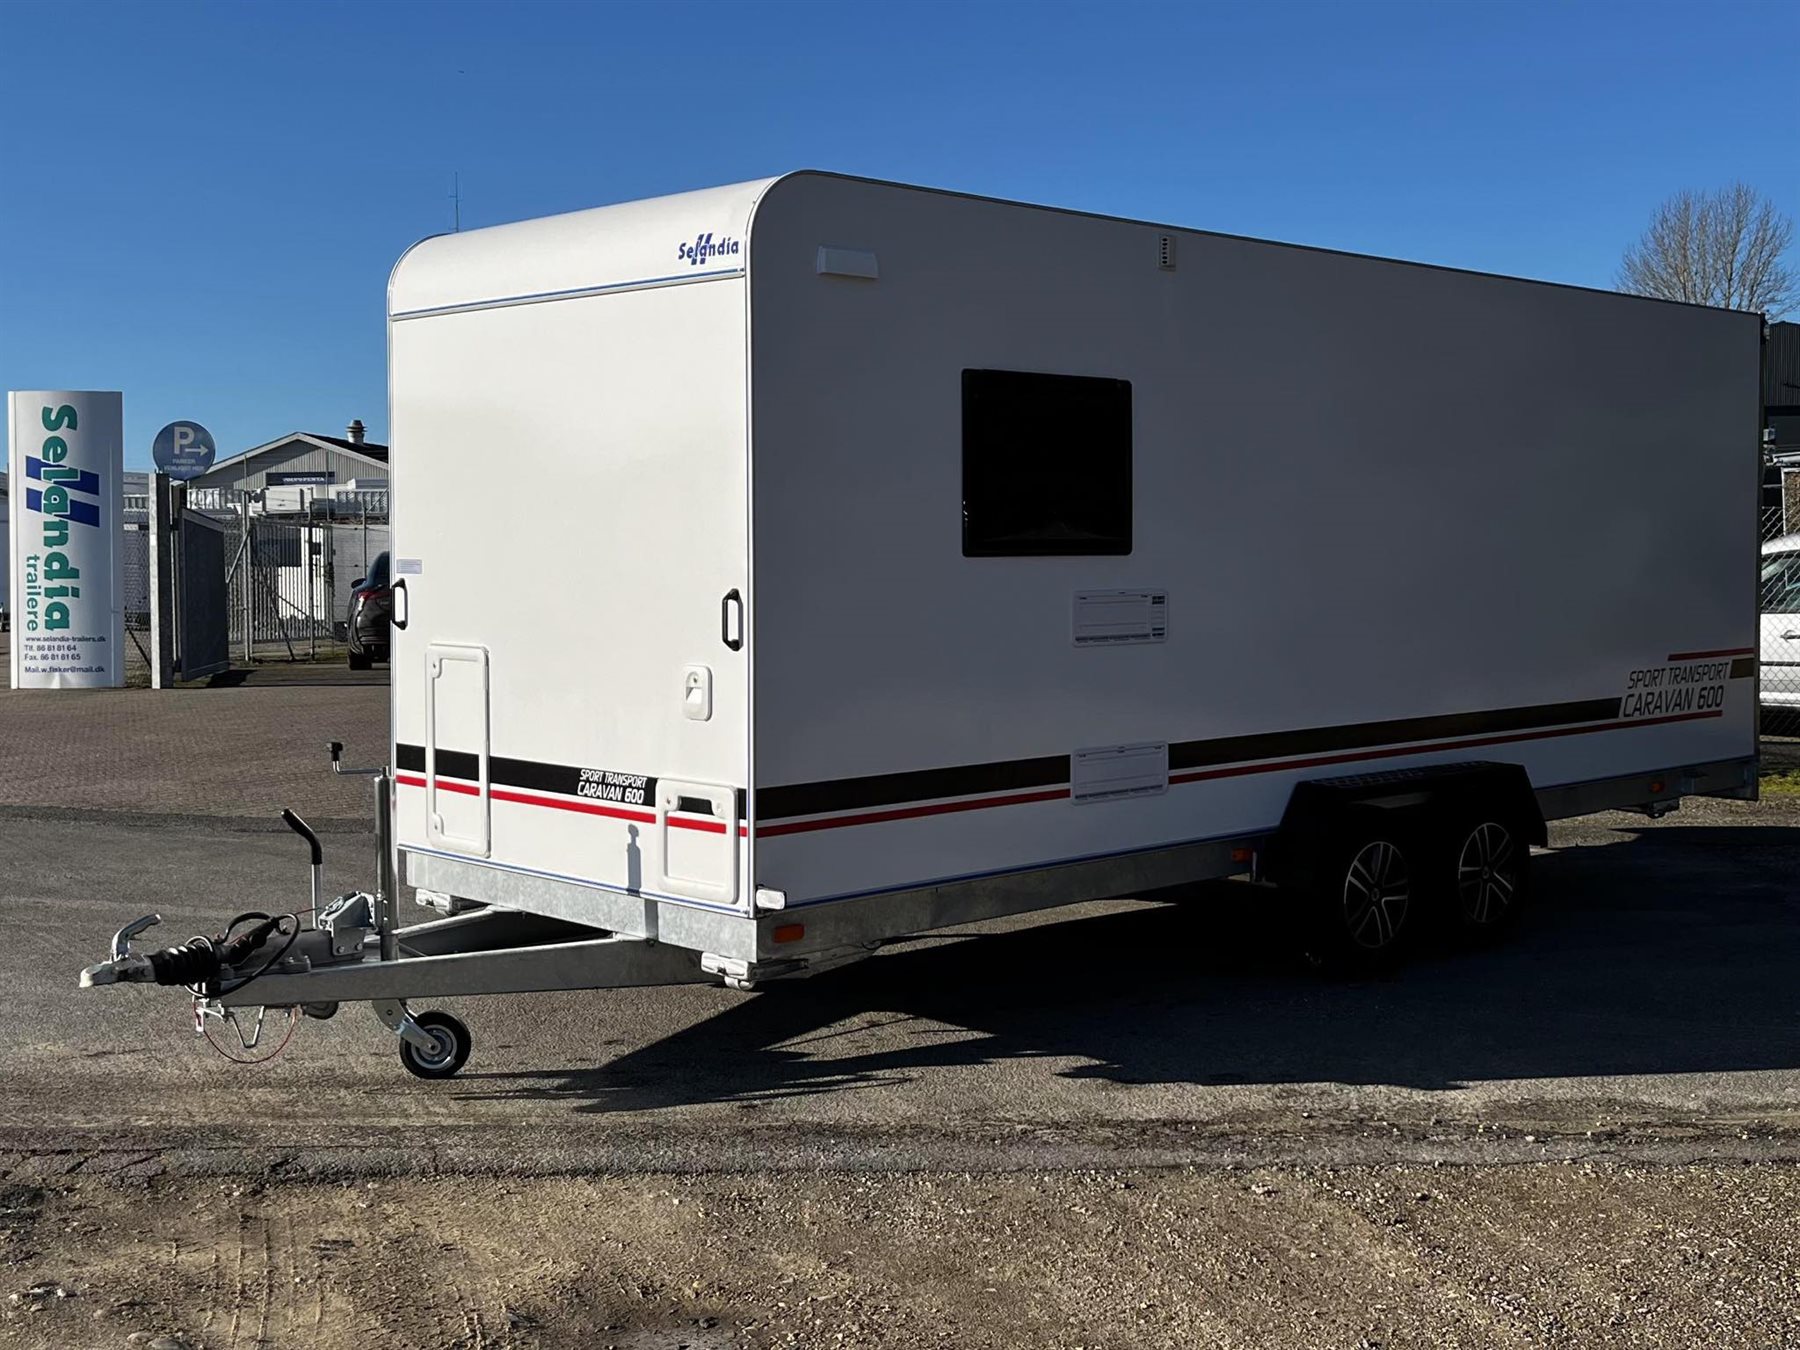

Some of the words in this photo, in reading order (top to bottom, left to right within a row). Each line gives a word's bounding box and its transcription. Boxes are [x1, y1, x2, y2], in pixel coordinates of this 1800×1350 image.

[678, 236, 739, 260] Selandia
[174, 426, 195, 455] P
[41, 404, 80, 632] Selandia
[26, 554, 42, 632] trailere
[24, 644, 35, 652] Tlf.
[36, 644, 46, 652] 86
[47, 644, 55, 652] 81
[56, 644, 65, 652] 81
[66, 644, 77, 652] 64
[24, 653, 39, 661] Fax.
[71, 653, 81, 661] 65
[1627, 667, 1666, 690] SPORT
[1667, 662, 1729, 686] TRANSPORT
[1623, 687, 1695, 718] CARAVAN
[1696, 685, 1724, 710] 600
[579, 769, 604, 783] SPORT
[604, 771, 648, 789] TRANSPORT
[577, 781, 623, 801] CARAVAN
[624, 788, 645, 804] 600
